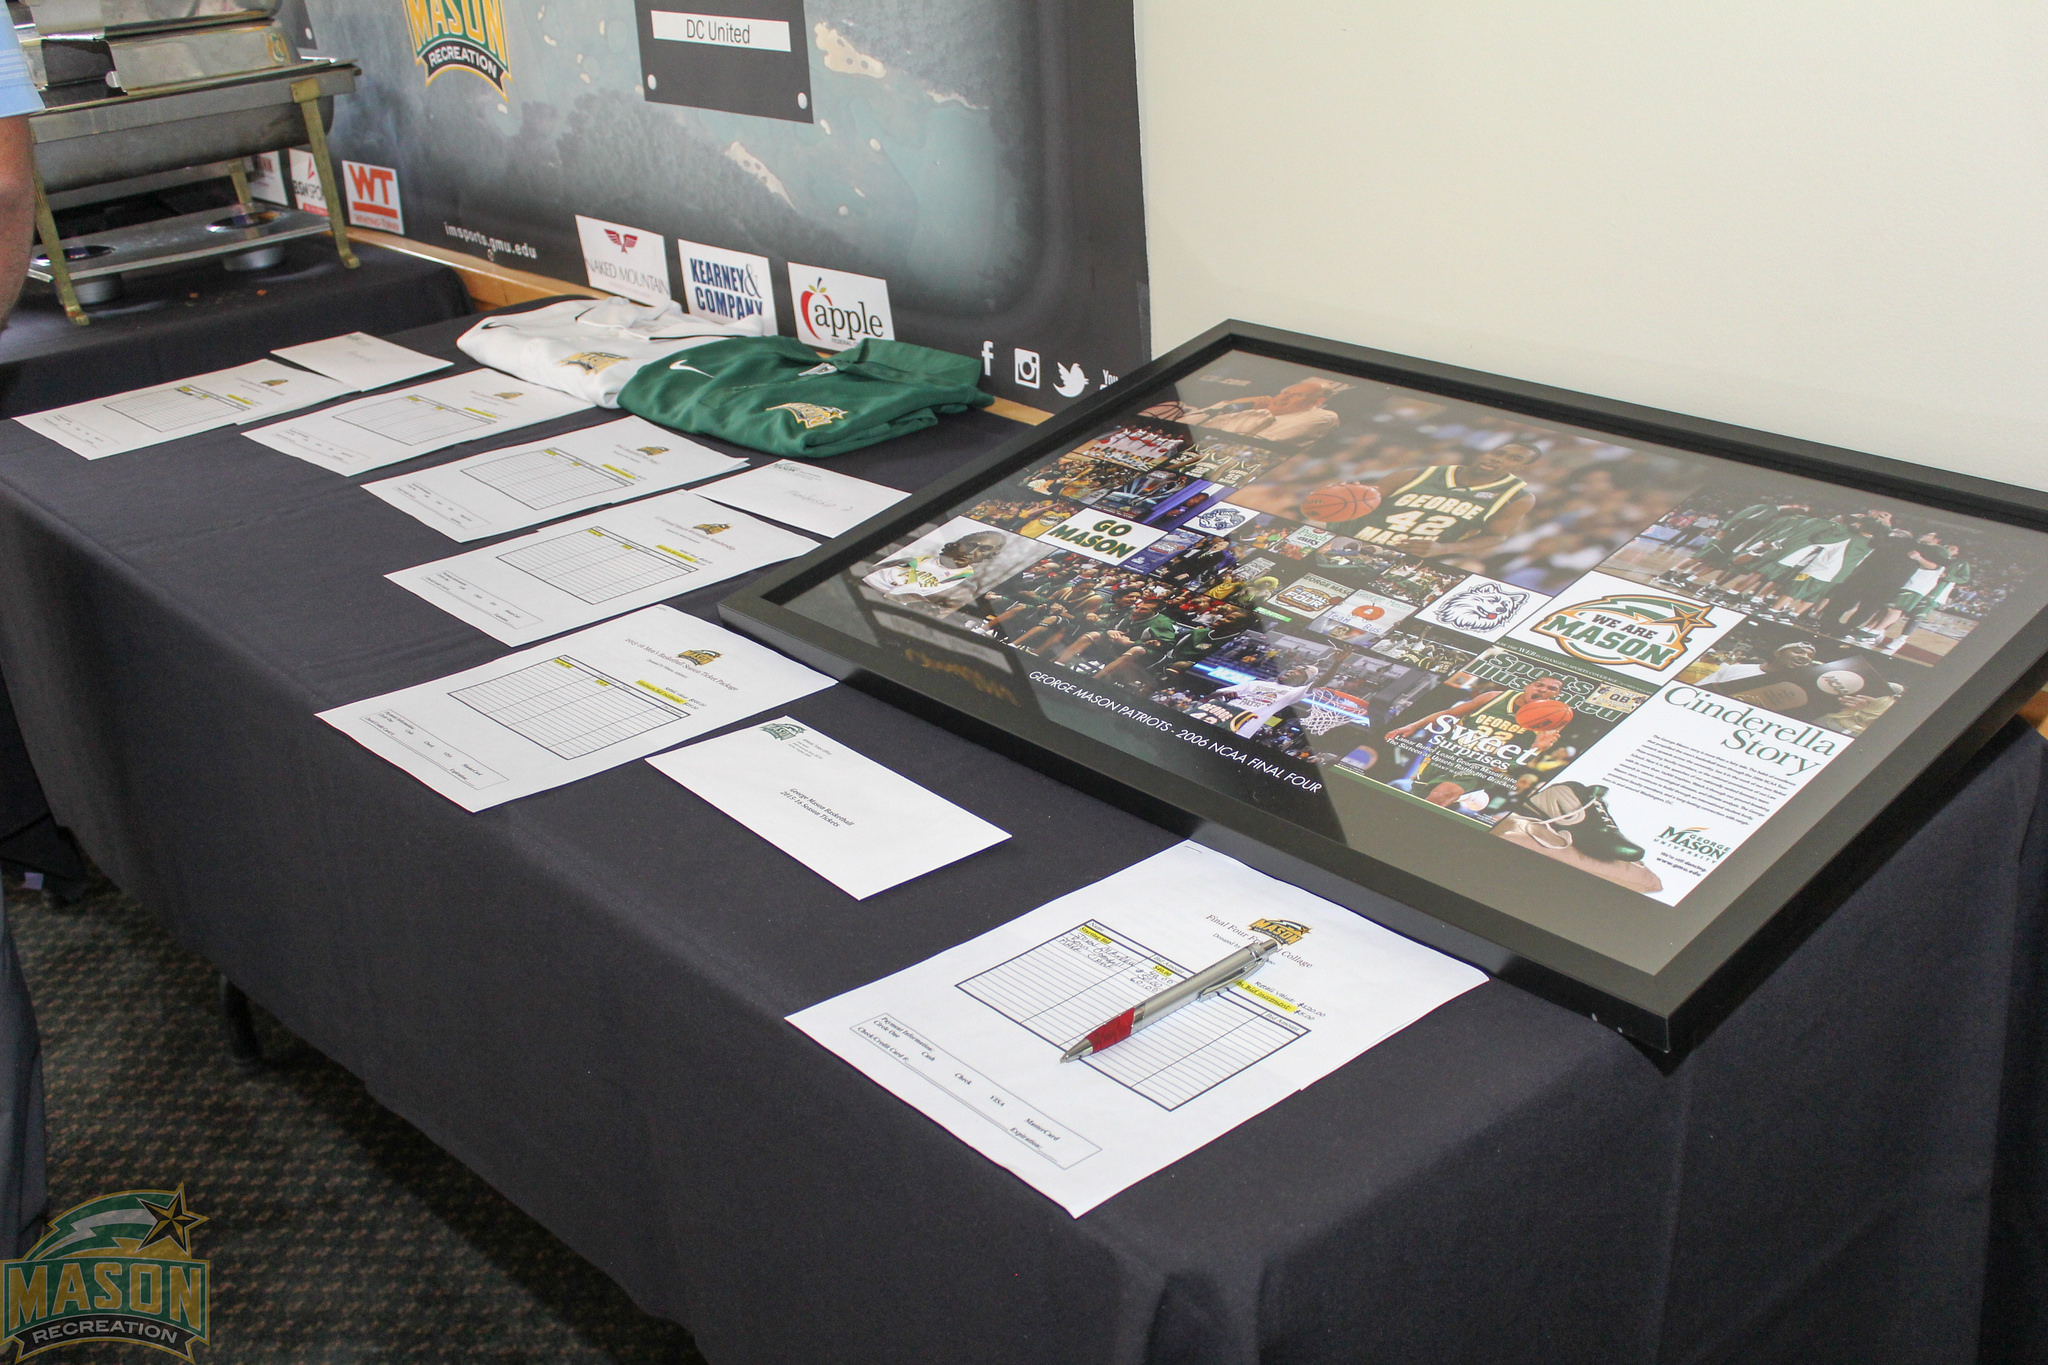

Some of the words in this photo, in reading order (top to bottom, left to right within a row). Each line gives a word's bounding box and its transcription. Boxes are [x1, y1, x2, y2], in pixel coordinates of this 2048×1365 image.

[405, 0, 508, 68] MASON
[687, 19, 705, 40] DC
[708, 20, 751, 45] United
[428, 45, 498, 78] RECREATION
[348, 163, 394, 205] WT
[443, 221, 538, 259] imsports.gmu.edu
[585, 257, 618, 279] NAKED
[618, 266, 669, 298] MOUNTAIN
[695, 286, 763, 321] COMPANY
[814, 301, 884, 341] apple
[1377, 504, 1458, 542] 42
[1393, 487, 1485, 525] GEORGE
[1047, 523, 1136, 559] MASON
[1089, 517, 1135, 538] GO
[1285, 591, 1325, 607] FOUR
[1299, 590, 1330, 603] FINAL
[1542, 614, 1677, 666] MASON
[1590, 613, 1622, 628] WE
[1619, 622, 1659, 639] ARE
[657, 653, 686, 665] Basketball
[682, 664, 701, 673] Season
[698, 671, 718, 681] Ticket
[715, 679, 738, 691] Package
[1609, 693, 1630, 703] QB
[1029, 671, 1076, 693] GEORGE
[1073, 689, 1120, 710] MASON
[1118, 706, 1172, 731] PATRIOTS
[1176, 729, 1209, 746] 2006
[1208, 742, 1247, 763] NCAA
[1247, 758, 1284, 777] FINAL
[1284, 773, 1322, 792] FOUR
[1423, 712, 1544, 766] Sweet
[1473, 712, 1528, 738] GEORGE
[1665, 687, 1834, 755] Cinderella
[1384, 738, 1400, 746] The
[1398, 743, 1425, 755] Sixteen
[1429, 755, 1454, 766] Upsets
[1453, 763, 1476, 775] Rattle
[1474, 771, 1489, 779] the
[1487, 776, 1517, 790] Brackets
[1393, 735, 1416, 745] Lamar
[1413, 742, 1437, 753] Butler
[1437, 751, 1456, 761] Leads
[1453, 757, 1478, 770] George
[1476, 766, 1502, 778] Mason
[1500, 773, 1517, 783] into
[1429, 735, 1510, 771] Surprises
[1721, 729, 1819, 776] Story
[790, 788, 809, 799] George
[807, 798, 825, 809] Mason
[823, 808, 854, 825] Basketball
[800, 803, 820, 815] Season
[819, 814, 840, 827] Tickets
[1654, 838, 1716, 863] UNIVERSITY
[1659, 826, 1729, 859] MASON
[1689, 834, 1730, 852] GEORGE
[1656, 857, 1701, 876] www.gmu.edu
[1089, 922, 1104, 931] Name
[1163, 962, 1184, 973] Amount
[1205, 914, 1230, 927] Final
[1227, 924, 1249, 937] Four
[1281, 951, 1312, 968] Collage
[1212, 933, 1235, 945] Donated
[1248, 918, 1303, 945] MASON
[1079, 927, 1103, 940] Starting
[1153, 965, 1172, 976] $40.00
[1243, 985, 1259, 994] Bid
[881, 1017, 903, 1031] Payment
[902, 1030, 934, 1052] Information:
[1275, 1018, 1299, 1031] Amount
[857, 1027, 890, 1049] Check/Credit
[889, 1047, 904, 1058] Card
[1010, 1127, 1042, 1149] Expiration:
[873, 1020, 889, 1031] Circle
[888, 1030, 900, 1038] One
[921, 1051, 935, 1061] Cash
[954, 1073, 972, 1085] Check
[990, 1095, 1005, 1107] VISA
[1025, 1118, 1060, 1141] MasterCard
